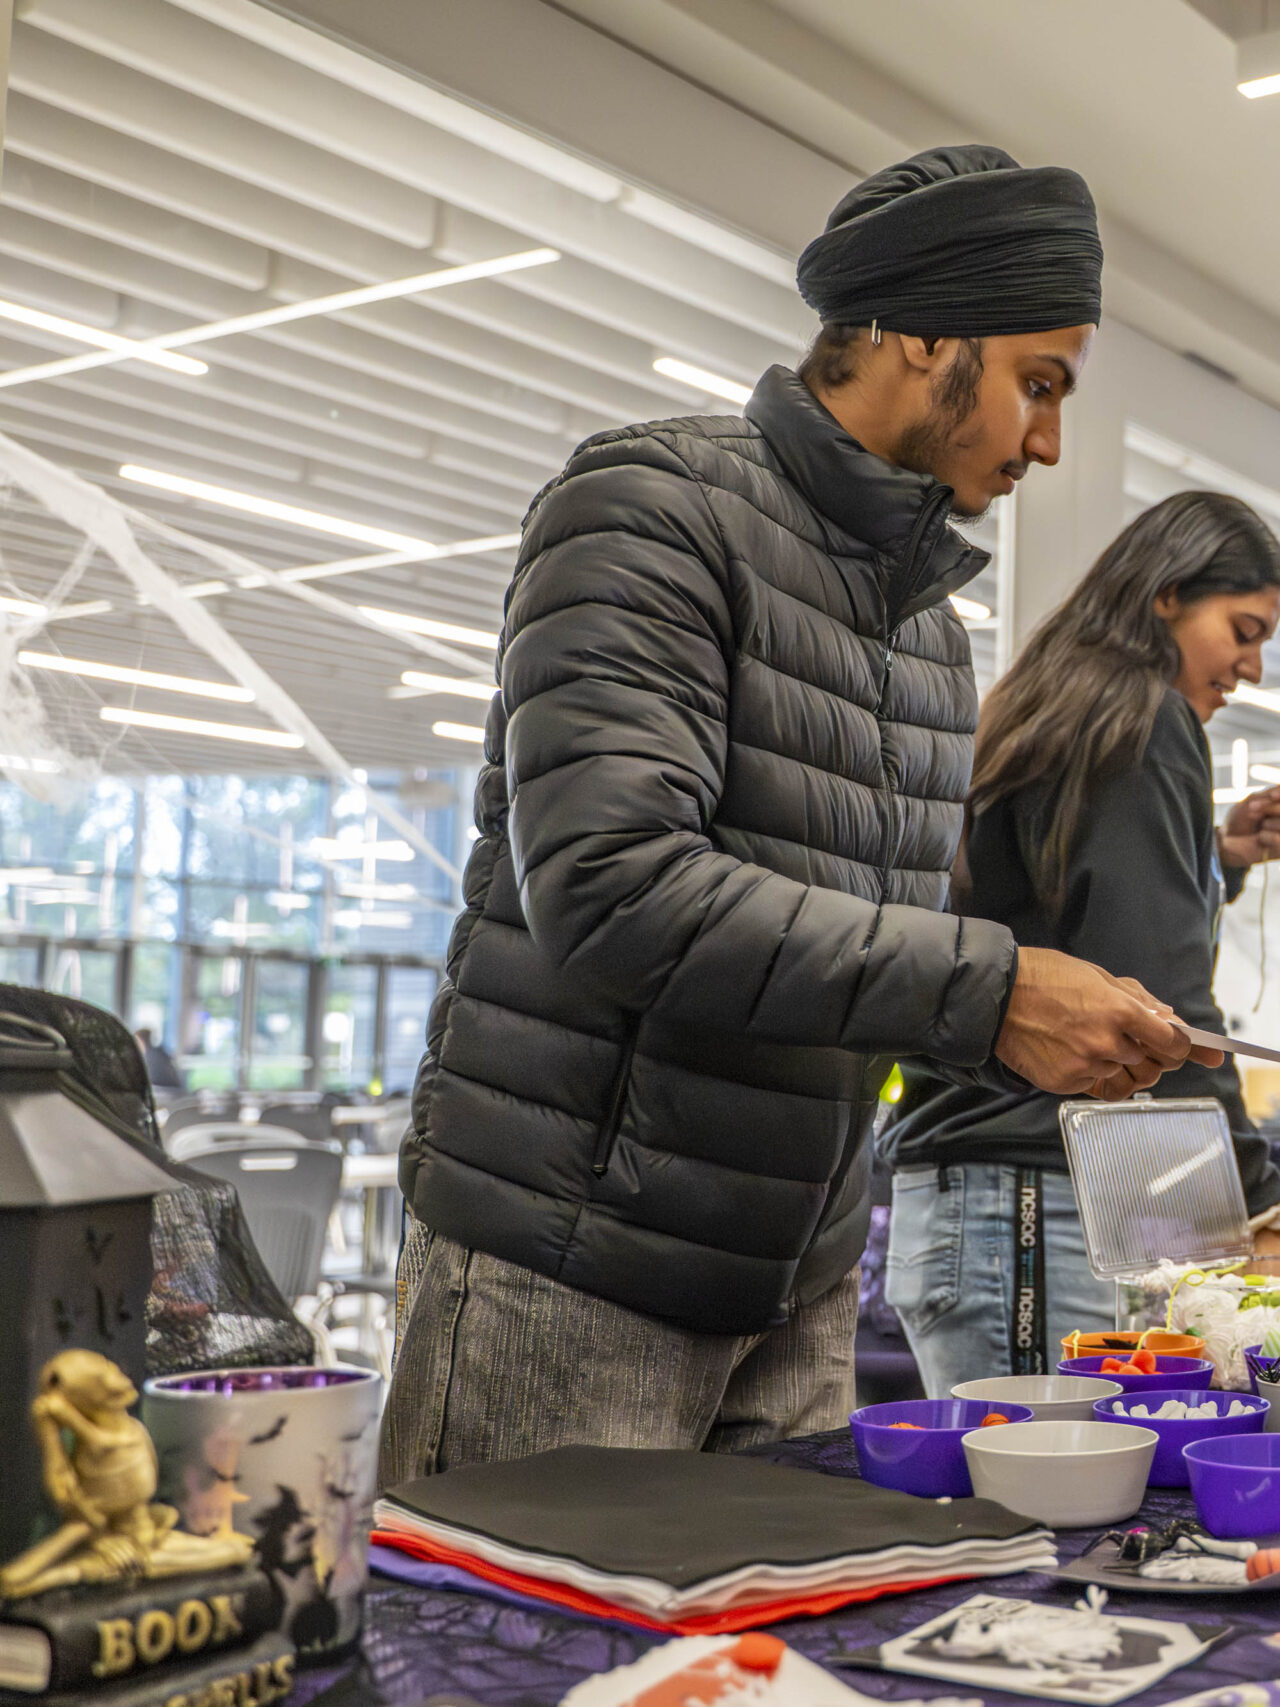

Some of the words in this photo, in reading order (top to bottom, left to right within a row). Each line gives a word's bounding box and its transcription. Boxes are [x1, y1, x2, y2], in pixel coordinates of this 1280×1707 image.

[1021, 1187, 1036, 1247] ncsac
[1018, 1287, 1034, 1349] ncsac
[92, 1593, 245, 1677] BOOK
